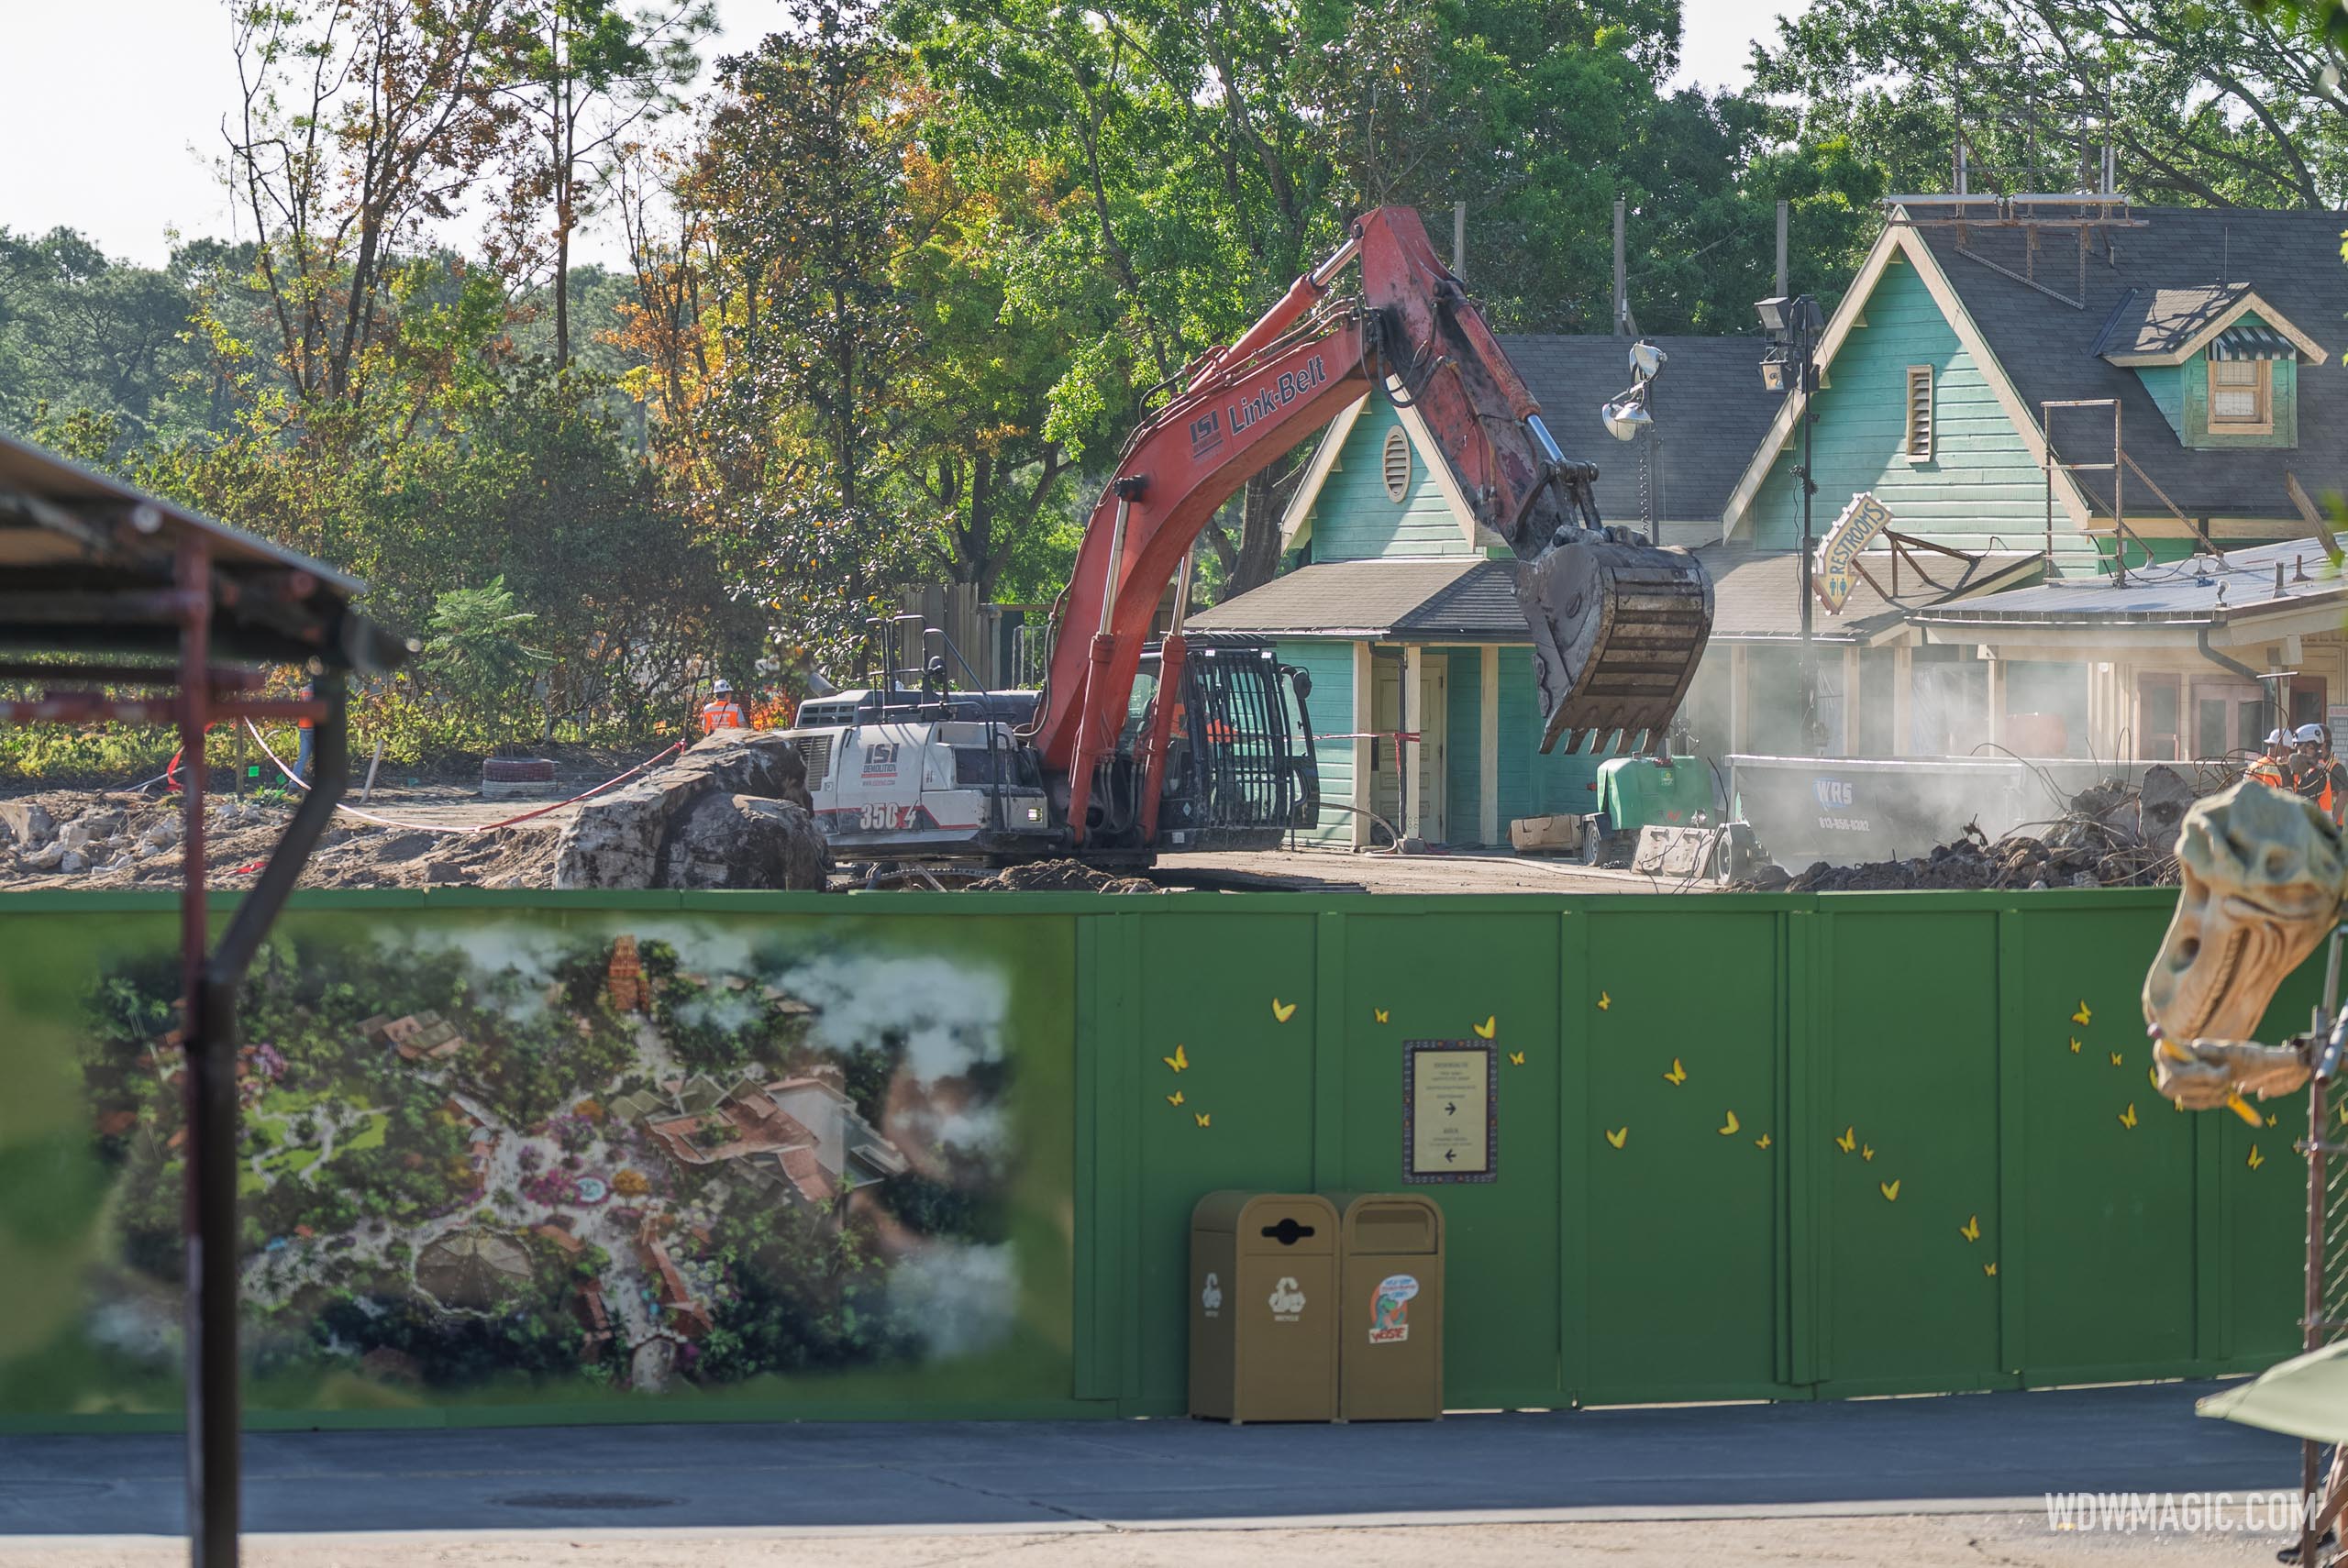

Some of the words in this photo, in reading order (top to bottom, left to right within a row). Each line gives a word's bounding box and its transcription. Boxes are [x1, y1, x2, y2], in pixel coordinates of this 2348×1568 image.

[1227, 354, 1327, 436] Link-Belt
[1829, 502, 1886, 575] RESTROOMS
[863, 763, 896, 773] DEMOLITION
